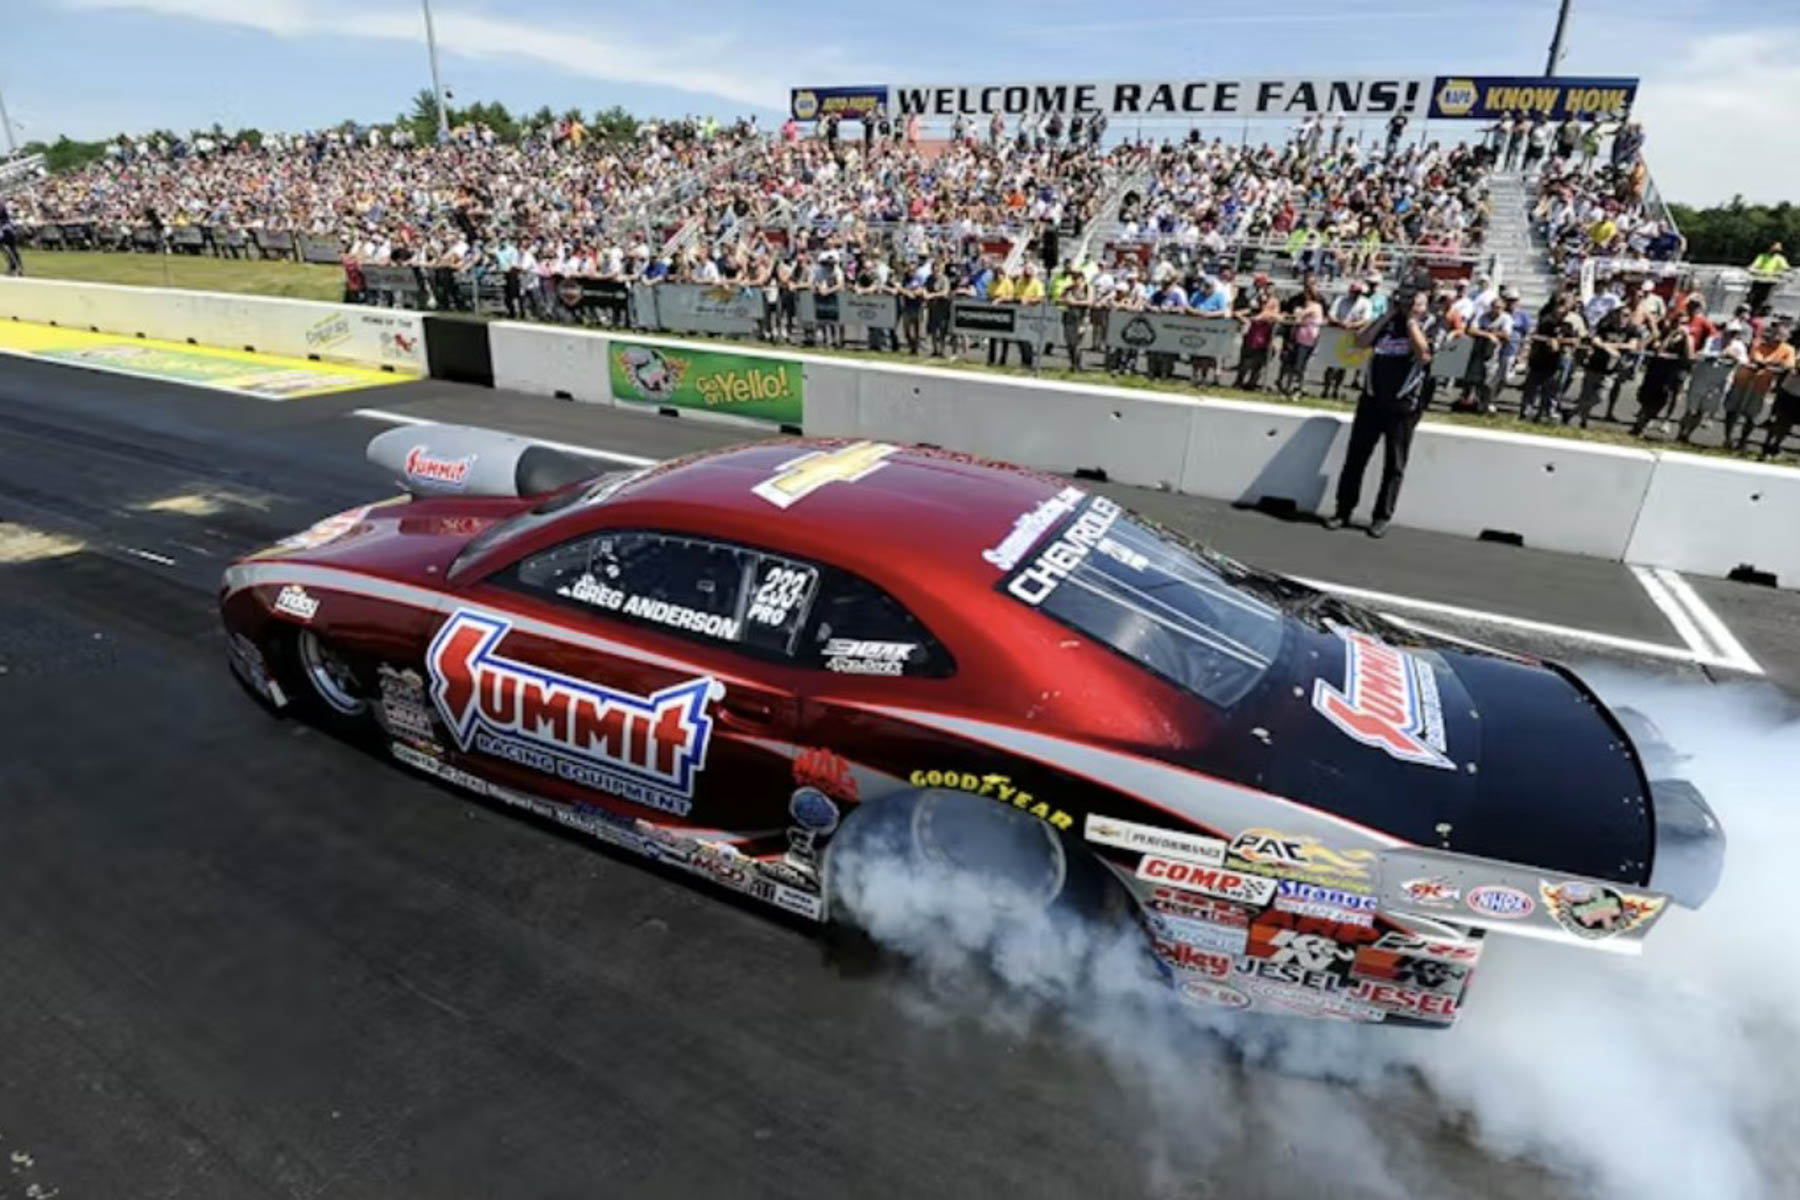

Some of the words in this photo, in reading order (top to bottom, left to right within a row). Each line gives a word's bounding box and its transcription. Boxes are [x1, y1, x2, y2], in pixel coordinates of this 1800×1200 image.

[897, 84, 1097, 114] WELCOME
[1112, 83, 1240, 112] RACE
[1255, 81, 1420, 112] FANS!
[1484, 87, 1560, 110] KNOW
[1564, 88, 1628, 113] HOW
[714, 365, 788, 402] Yello!
[572, 583, 624, 610] GREG
[623, 595, 739, 640] ANDERSON
[747, 603, 786, 626] PRO
[476, 732, 556, 774] RACING
[557, 759, 692, 817] EQUIPMENT
[910, 769, 1073, 830] GOODYEAR
[1233, 833, 1308, 862] PAC
[1145, 860, 1242, 893] COMP
[1278, 879, 1378, 910] Strange
[1235, 959, 1346, 993] JESEL
[1351, 982, 1457, 1016] JESEL
